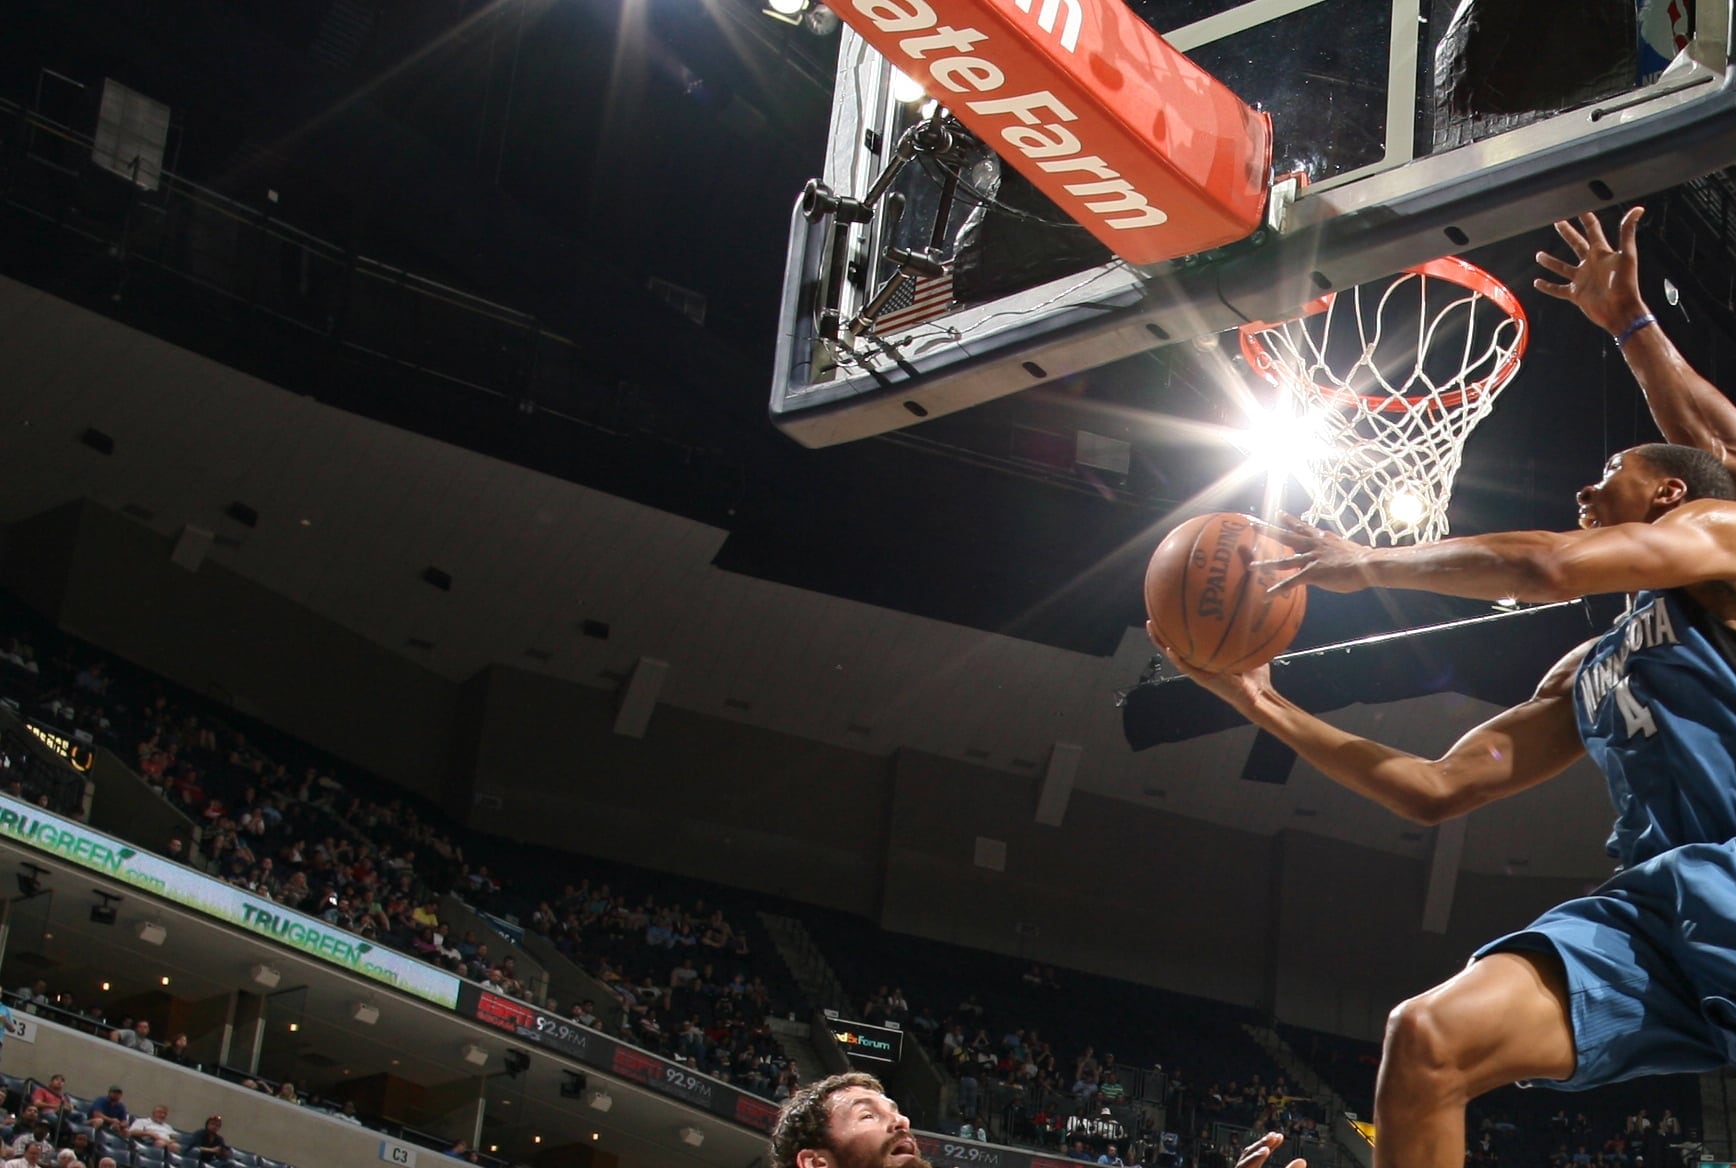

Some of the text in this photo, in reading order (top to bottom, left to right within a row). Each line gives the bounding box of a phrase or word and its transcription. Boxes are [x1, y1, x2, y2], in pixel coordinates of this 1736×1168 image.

[856, 0, 1005, 93] ate
[965, 90, 1168, 230] Farm
[1197, 520, 1246, 621] SPALDING
[1580, 597, 1680, 724] MINNOTA
[1615, 674, 1657, 738] 4
[0, 806, 124, 870] RUGREEN
[242, 903, 362, 965] TRUGREEN
[393, 1148, 408, 1164] C3
[943, 1143, 999, 1166] 92.9FM
